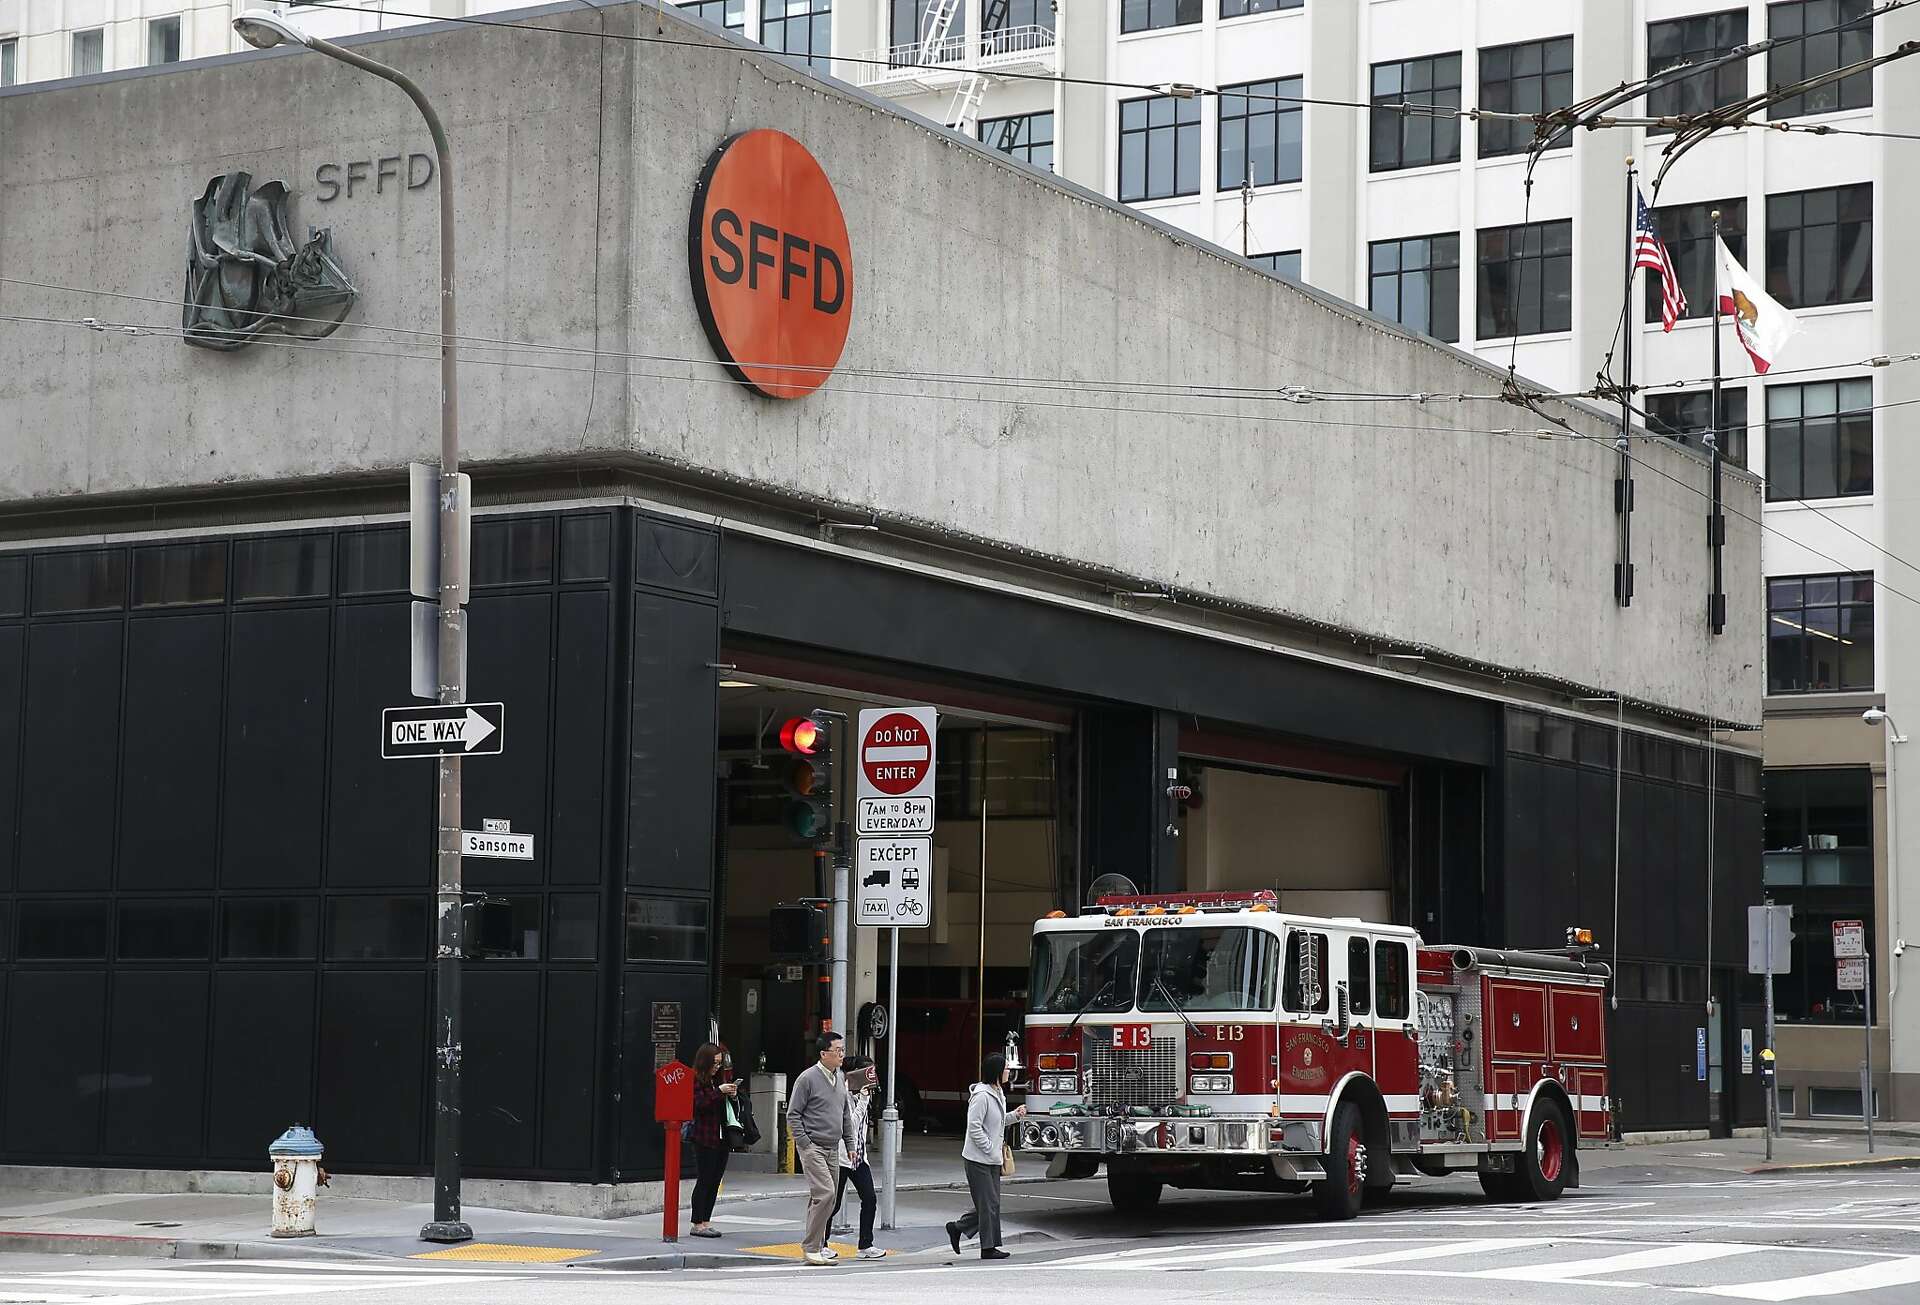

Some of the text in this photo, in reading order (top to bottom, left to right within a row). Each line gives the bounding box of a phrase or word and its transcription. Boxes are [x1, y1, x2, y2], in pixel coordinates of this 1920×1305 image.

[316, 153, 434, 201] SFFD
[710, 208, 845, 315] SFFD
[396, 721, 466, 742] ONE WAY
[875, 729, 919, 743] DO NOT
[876, 767, 916, 780] ENTER
[866, 802, 926, 816] 7AM TO 8PM
[494, 822, 508, 832] 600
[866, 818, 925, 829] EVERYDAY
[470, 836, 525, 853] Sansome
[870, 848, 918, 862] EXCEPT
[865, 904, 887, 912] TAXI
[1104, 917, 1182, 927] SAN FRANCISCO
[1113, 1026, 1151, 1047] E 13
[1216, 1025, 1244, 1041] E 13
